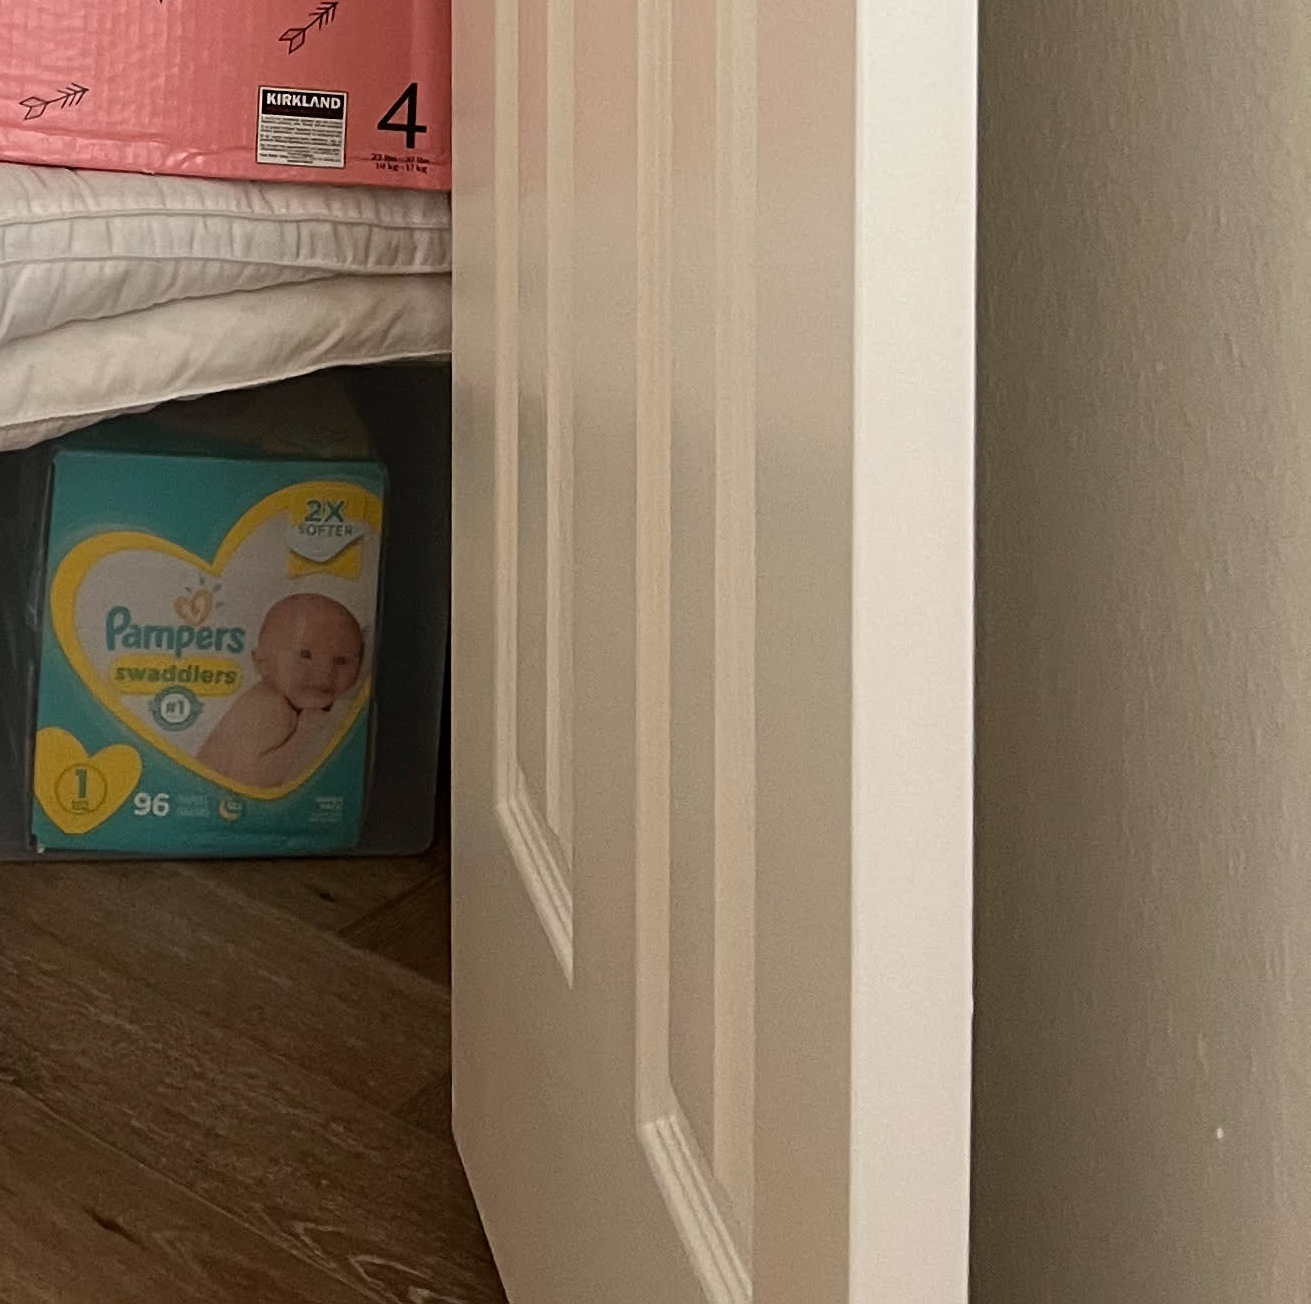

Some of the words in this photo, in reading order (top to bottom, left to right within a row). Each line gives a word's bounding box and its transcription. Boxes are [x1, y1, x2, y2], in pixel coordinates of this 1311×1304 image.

[266, 92, 342, 110] KIRKLAND
[376, 82, 428, 150] 4
[304, 499, 347, 523] 2X
[297, 522, 355, 538] SOFTER
[105, 605, 246, 659] Pampers
[114, 664, 239, 685] swaddlers
[165, 698, 186, 715] #1
[74, 768, 88, 799] 1
[132, 793, 171, 818] 96
